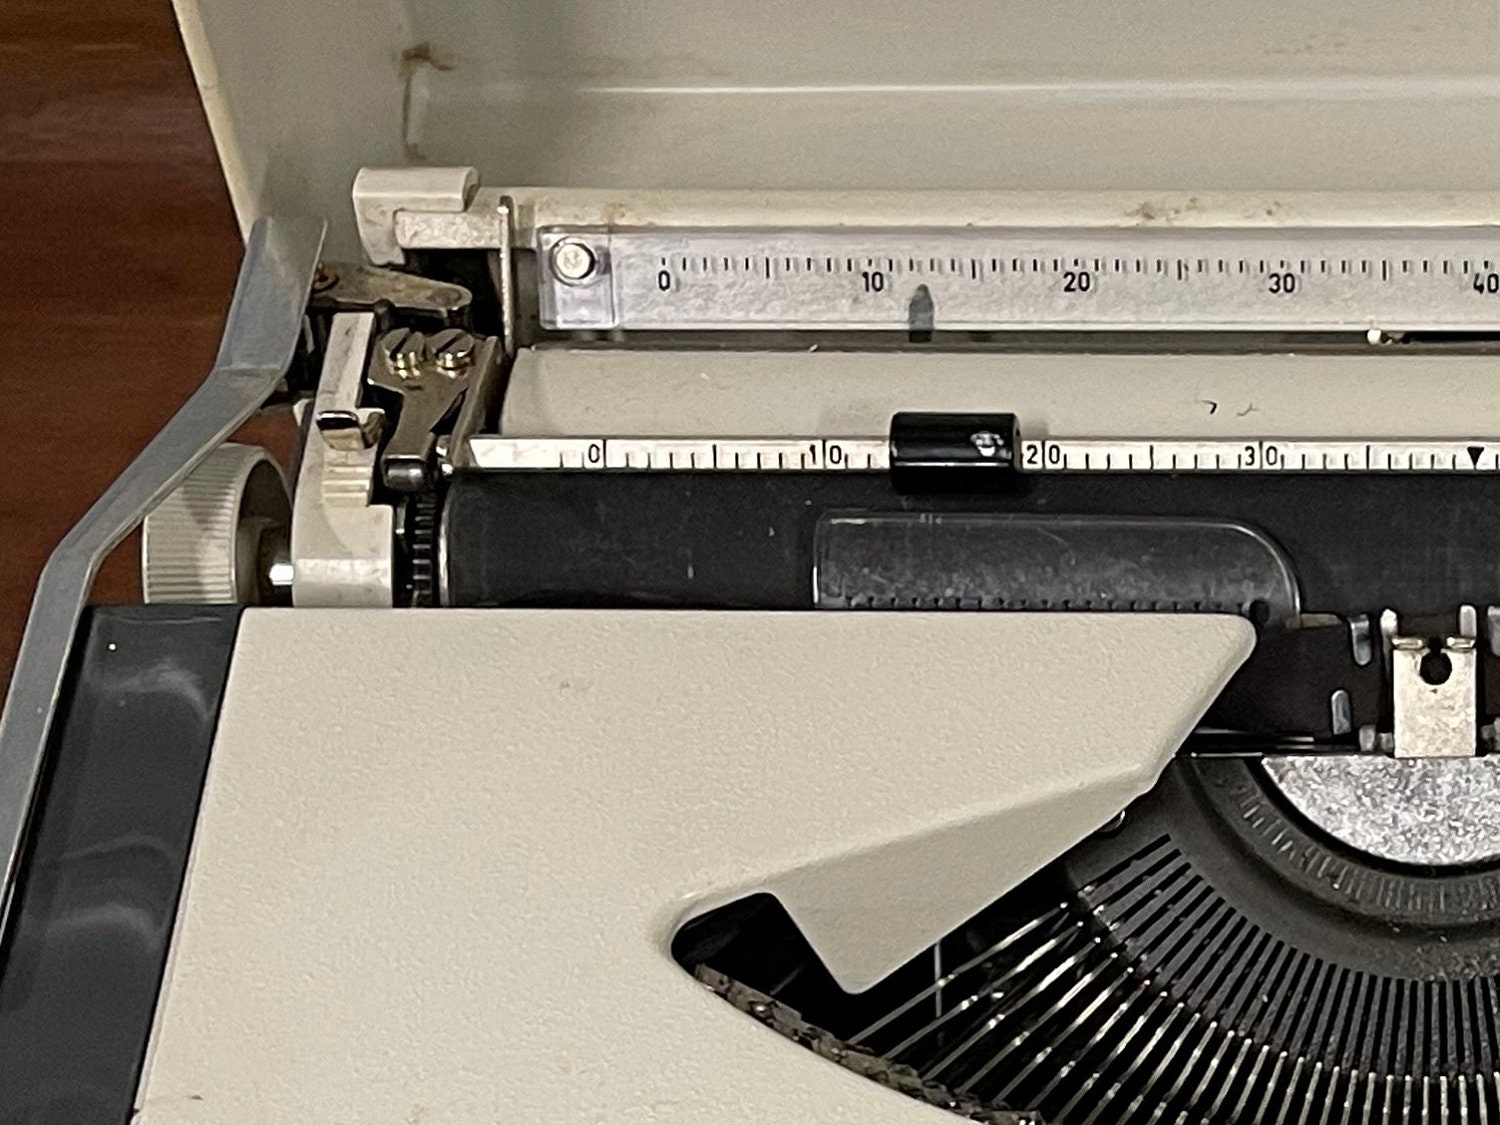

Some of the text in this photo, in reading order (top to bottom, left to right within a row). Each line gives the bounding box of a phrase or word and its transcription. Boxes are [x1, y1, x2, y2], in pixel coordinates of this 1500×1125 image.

[658, 270, 671, 292] 0
[861, 271, 884, 293] 10
[1062, 271, 1091, 293] 20
[1268, 272, 1296, 294] 30
[1473, 272, 1500, 295] 40
[587, 444, 600, 465] 0
[808, 444, 842, 466] 10
[1026, 443, 1060, 465] 20
[1244, 444, 1278, 467] 30
